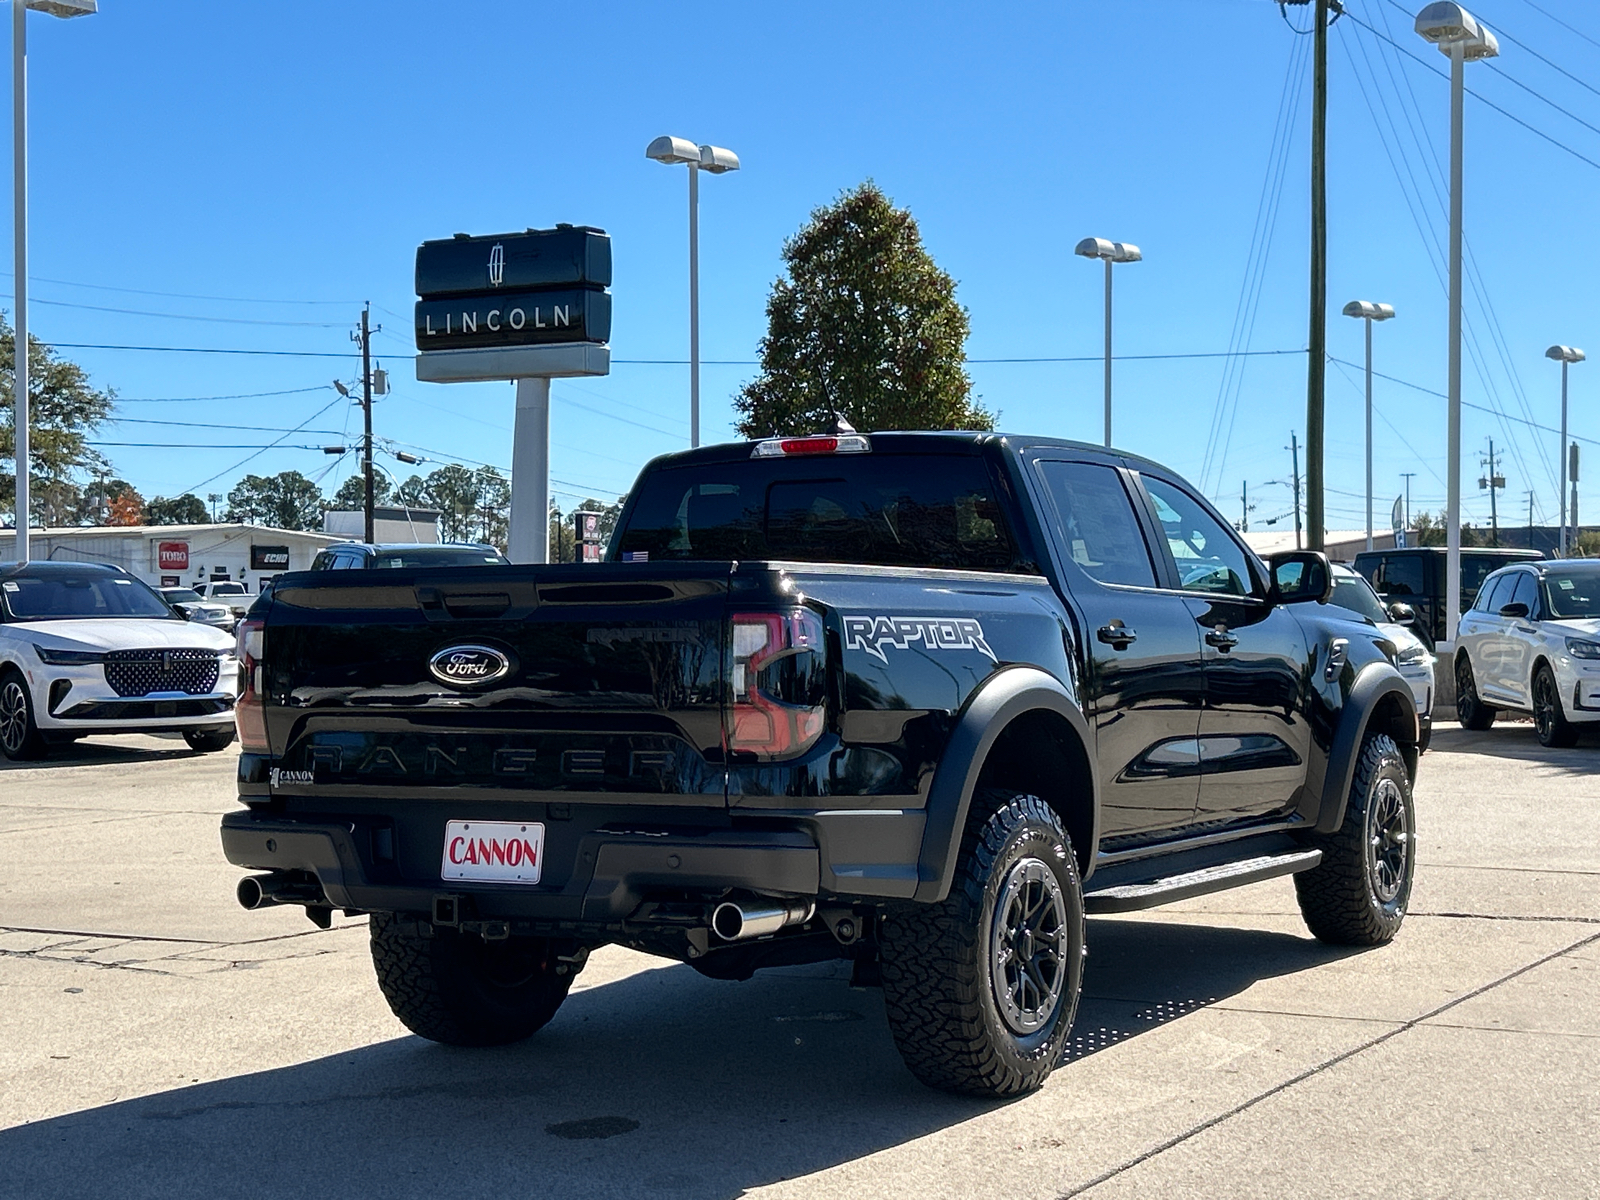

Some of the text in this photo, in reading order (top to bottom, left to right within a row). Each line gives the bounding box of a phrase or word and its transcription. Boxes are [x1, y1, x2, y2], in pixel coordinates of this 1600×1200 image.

[426, 305, 569, 336] LINCOLN
[161, 551, 187, 562] TORO
[264, 553, 288, 563] ECHO
[842, 616, 999, 665] RAPTOR
[446, 653, 488, 675] Ford
[305, 744, 677, 777] RANGER
[280, 770, 314, 781] CANNON
[449, 836, 539, 867] CANNON
